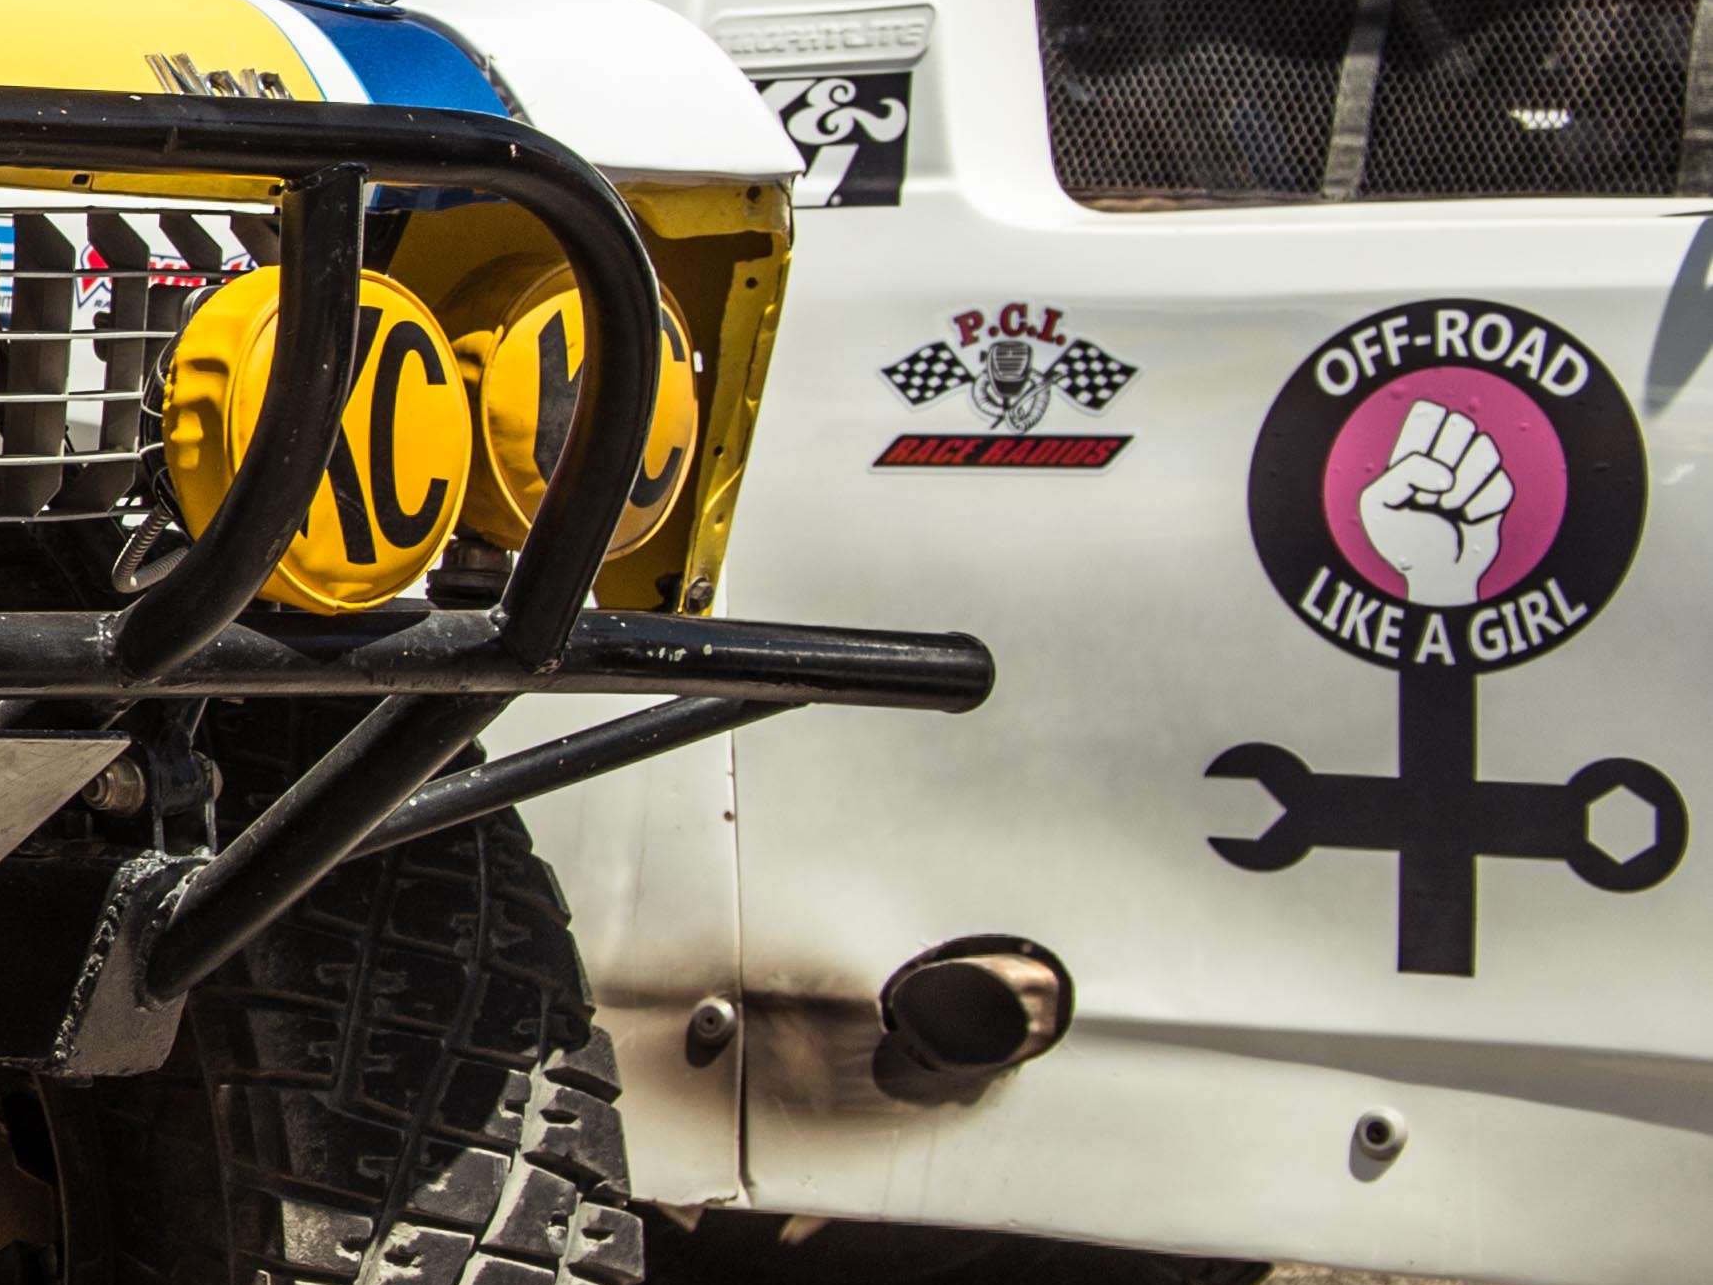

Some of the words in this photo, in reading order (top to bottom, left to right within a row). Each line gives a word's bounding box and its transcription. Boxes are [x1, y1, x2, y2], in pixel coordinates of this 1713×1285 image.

[1313, 308, 1590, 397] OFF-ROAD
[886, 436, 978, 465] RACE
[979, 437, 1120, 465] RADIOS
[1298, 566, 1406, 659] LIKE
[1414, 613, 1457, 666] A
[1466, 577, 1589, 662] GIRL
